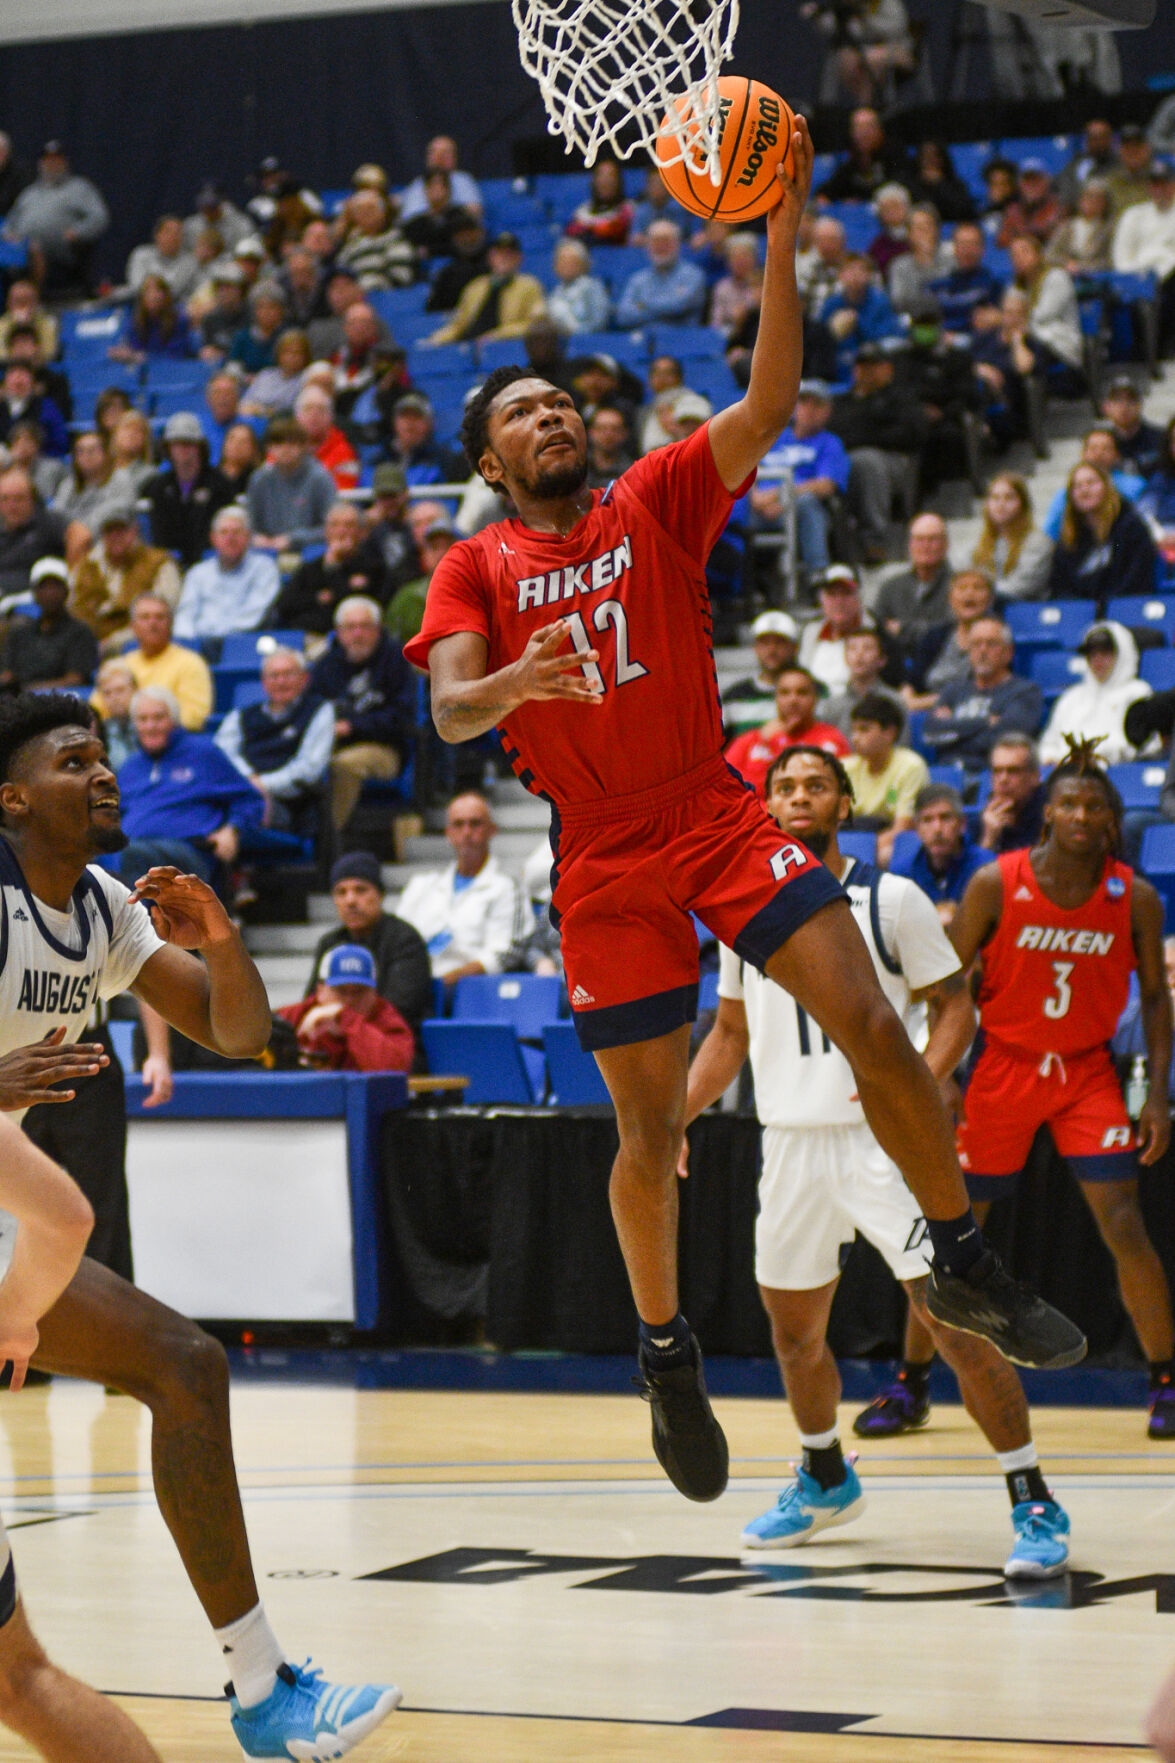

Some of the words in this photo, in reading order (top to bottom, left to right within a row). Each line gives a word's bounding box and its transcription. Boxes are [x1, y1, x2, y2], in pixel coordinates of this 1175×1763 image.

[737, 96, 779, 187] Wilson
[516, 534, 633, 613] AIKEN
[558, 598, 650, 694] 12
[768, 843, 808, 881] A
[1016, 925, 1115, 956] AIKEN
[1044, 961, 1075, 1019] 3
[1101, 1126, 1130, 1148] A
